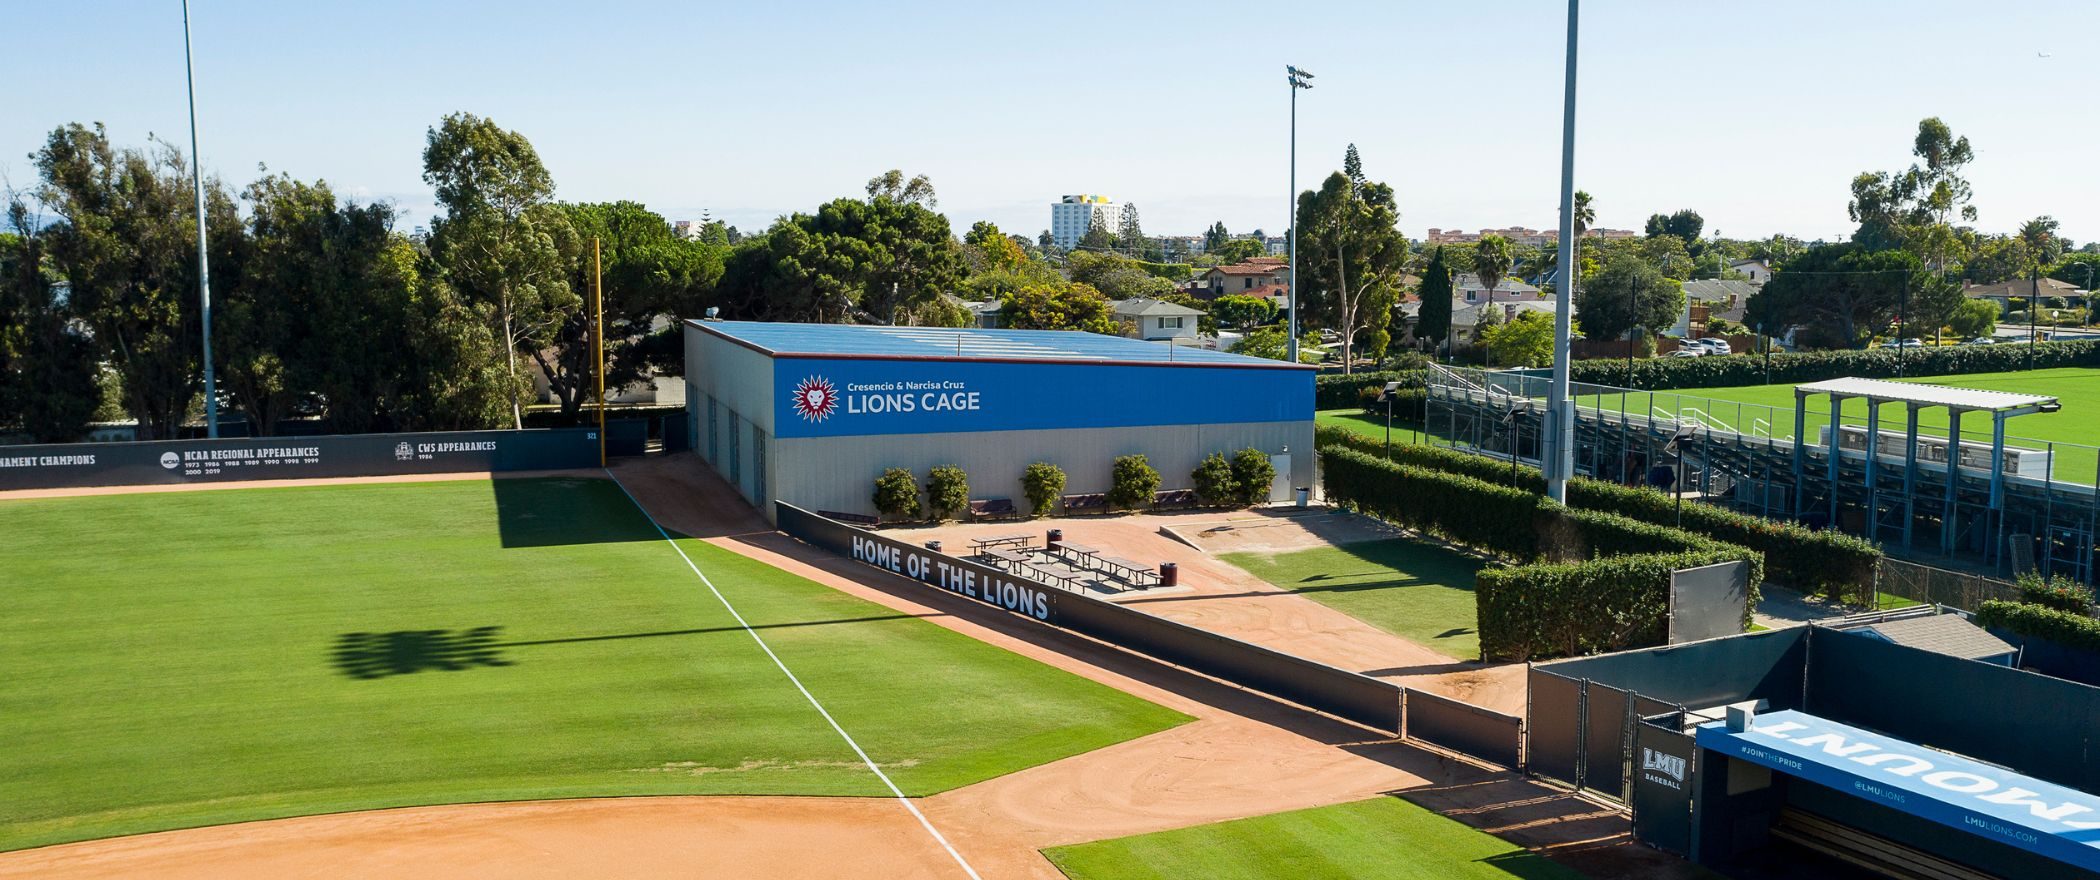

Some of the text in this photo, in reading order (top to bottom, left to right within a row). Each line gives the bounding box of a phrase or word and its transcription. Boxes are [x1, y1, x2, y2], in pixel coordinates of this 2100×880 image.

[847, 380, 965, 391] Cresencio & Narcisa Cruz
[848, 391, 980, 414] LIONS CAGE
[418, 443, 436, 453] CWS
[437, 441, 497, 452] APPEARANCES
[587, 432, 597, 440] 321
[40, 454, 96, 466] CHAMPIONS
[184, 446, 319, 461] NCAA REGIONAL APPEARANCES
[852, 535, 1048, 620] HOME OF THE LIONS
[1643, 747, 1686, 782] LMU
[1741, 746, 1803, 770] #JOINTHEPRIDE
[1645, 773, 1681, 790] BASEBALL
[1753, 721, 2100, 829] MOUNT
[1854, 780, 1906, 803] @LMULIONS
[1964, 815, 2038, 845] LMULIONS.COM
